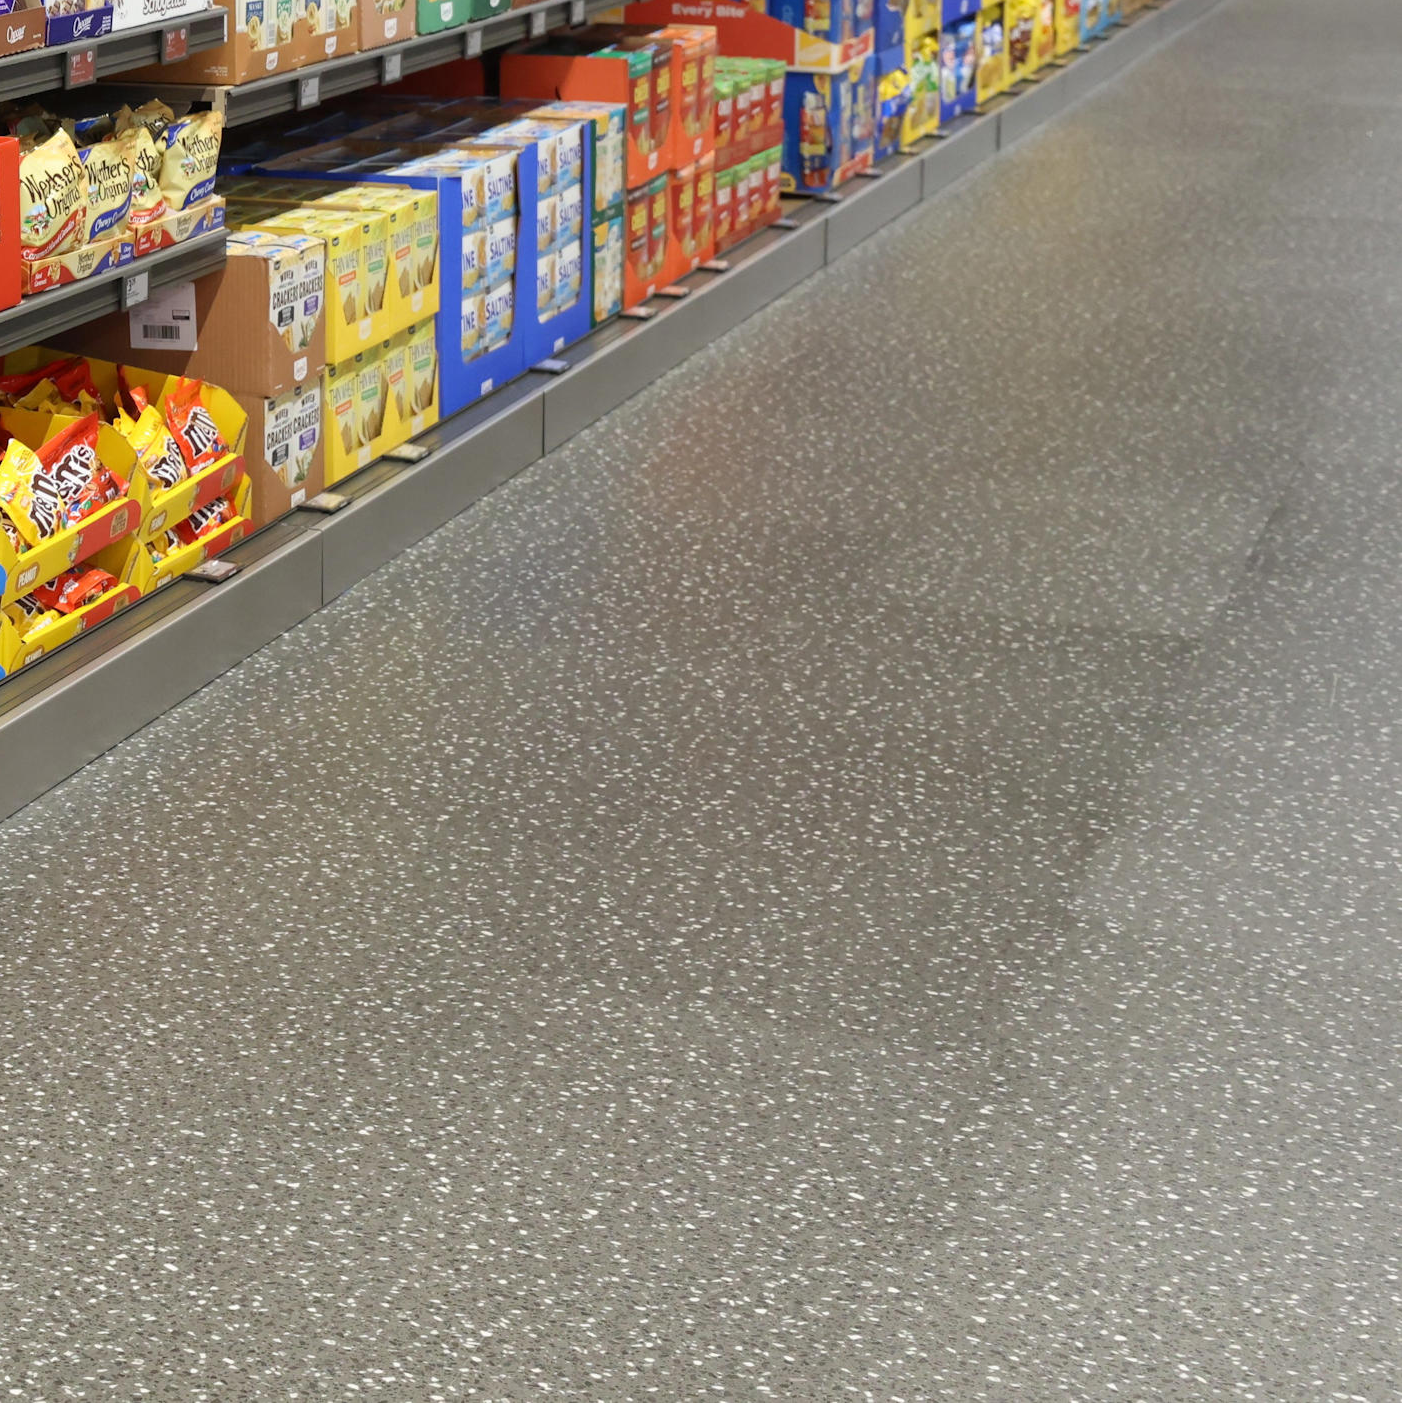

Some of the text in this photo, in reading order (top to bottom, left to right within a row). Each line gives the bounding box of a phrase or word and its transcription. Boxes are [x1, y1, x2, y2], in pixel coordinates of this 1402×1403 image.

[672, 5, 746, 19] Every Bite
[21, 154, 82, 204] Werther's
[86, 156, 131, 185] Werther's
[46, 185, 81, 219] Original
[98, 178, 130, 201] Original
[273, 282, 298, 310] CRACKERS
[299, 275, 323, 300] CRACKERS
[293, 407, 320, 435] CRACKERS
[266, 421, 293, 451] CRACKERS
[18, 566, 38, 588] PEANUT
